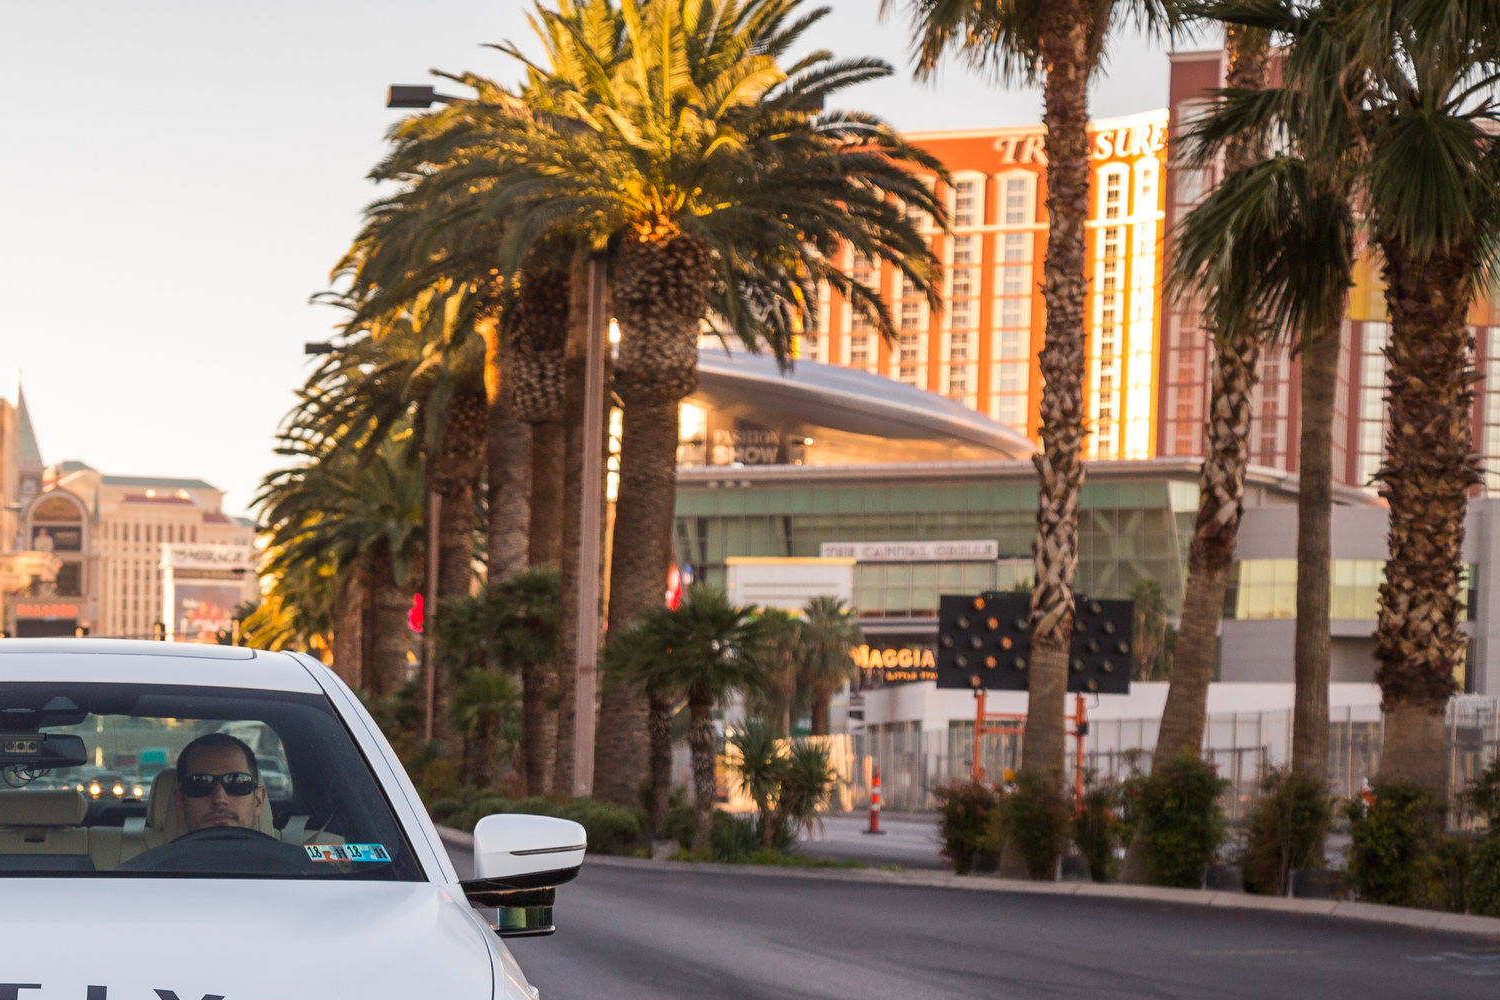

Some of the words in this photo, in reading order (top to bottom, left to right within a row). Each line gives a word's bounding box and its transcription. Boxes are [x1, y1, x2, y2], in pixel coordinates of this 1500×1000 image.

[993, 122, 1169, 167] TRSURE
[711, 444, 779, 465] SHOW
[307, 846, 323, 859] 18
[346, 845, 363, 858] 18
